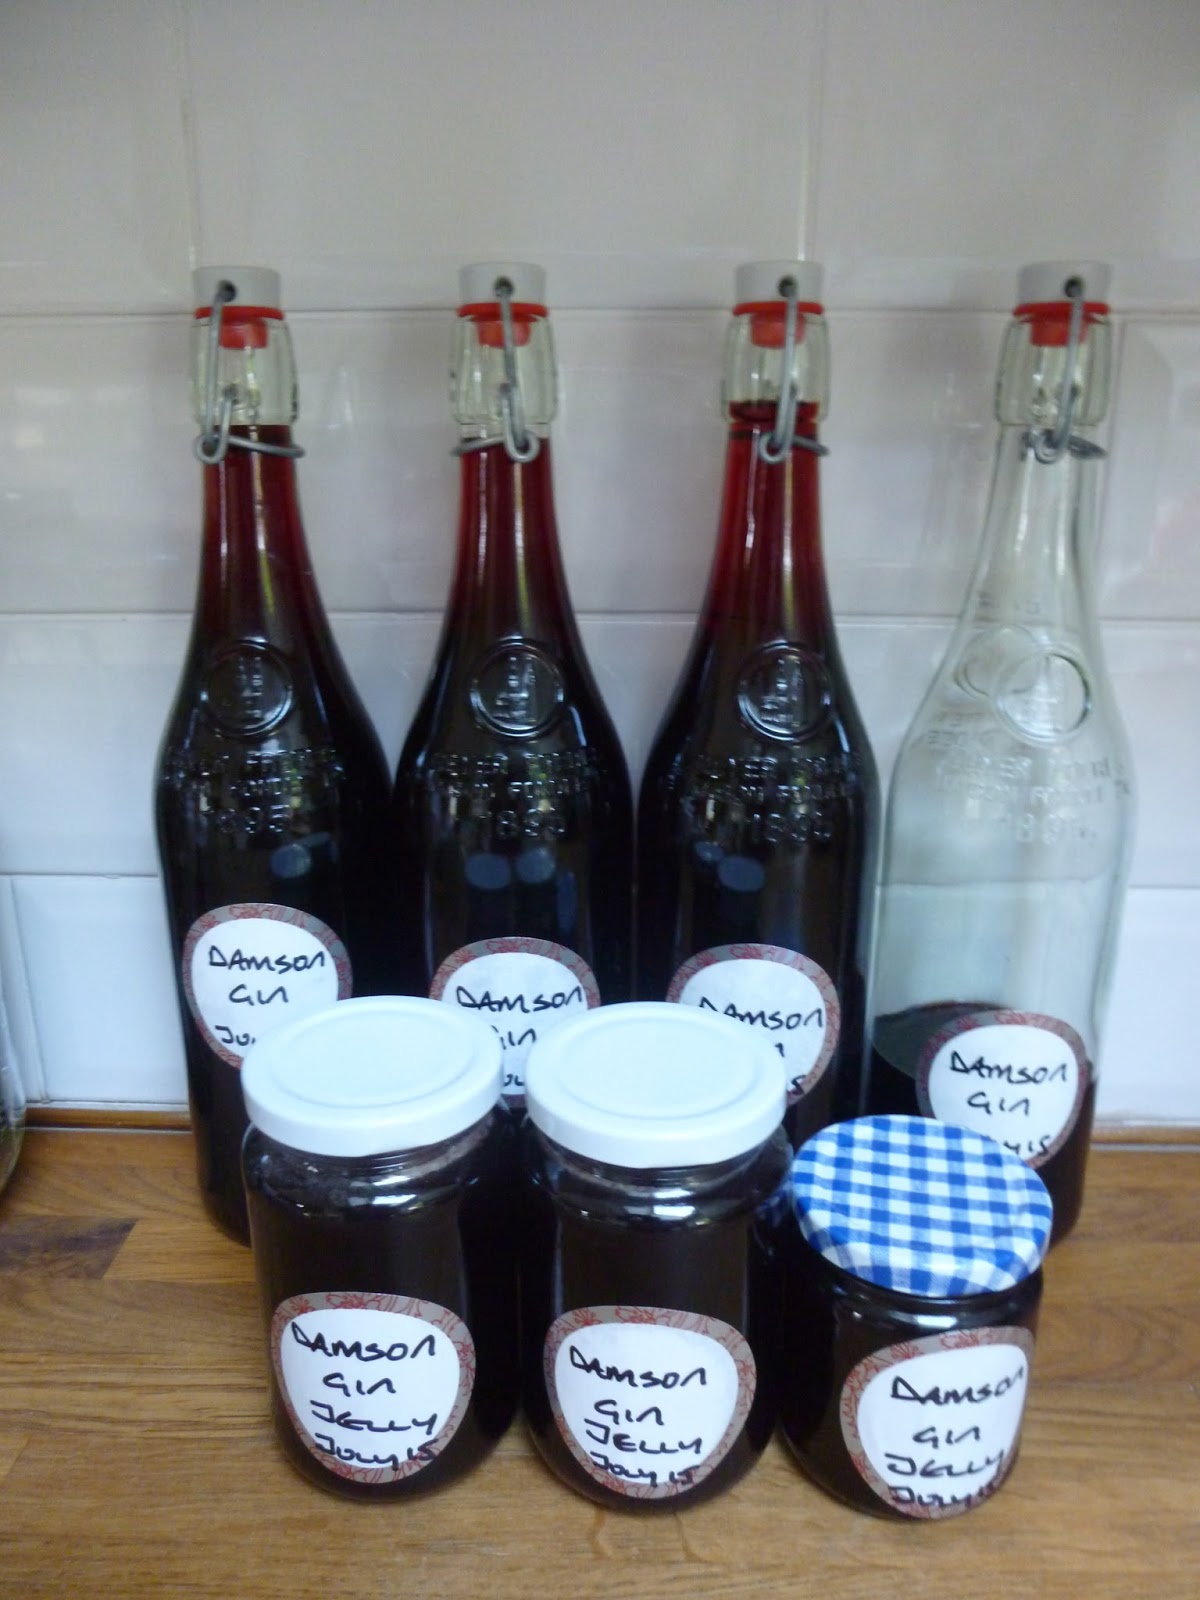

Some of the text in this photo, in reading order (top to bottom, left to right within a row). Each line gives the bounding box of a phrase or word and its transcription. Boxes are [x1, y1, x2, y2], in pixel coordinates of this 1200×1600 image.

[310, 1399, 438, 1435] JELLY
[584, 1418, 703, 1454] JELLY
[885, 1448, 1005, 1478] JELLY
